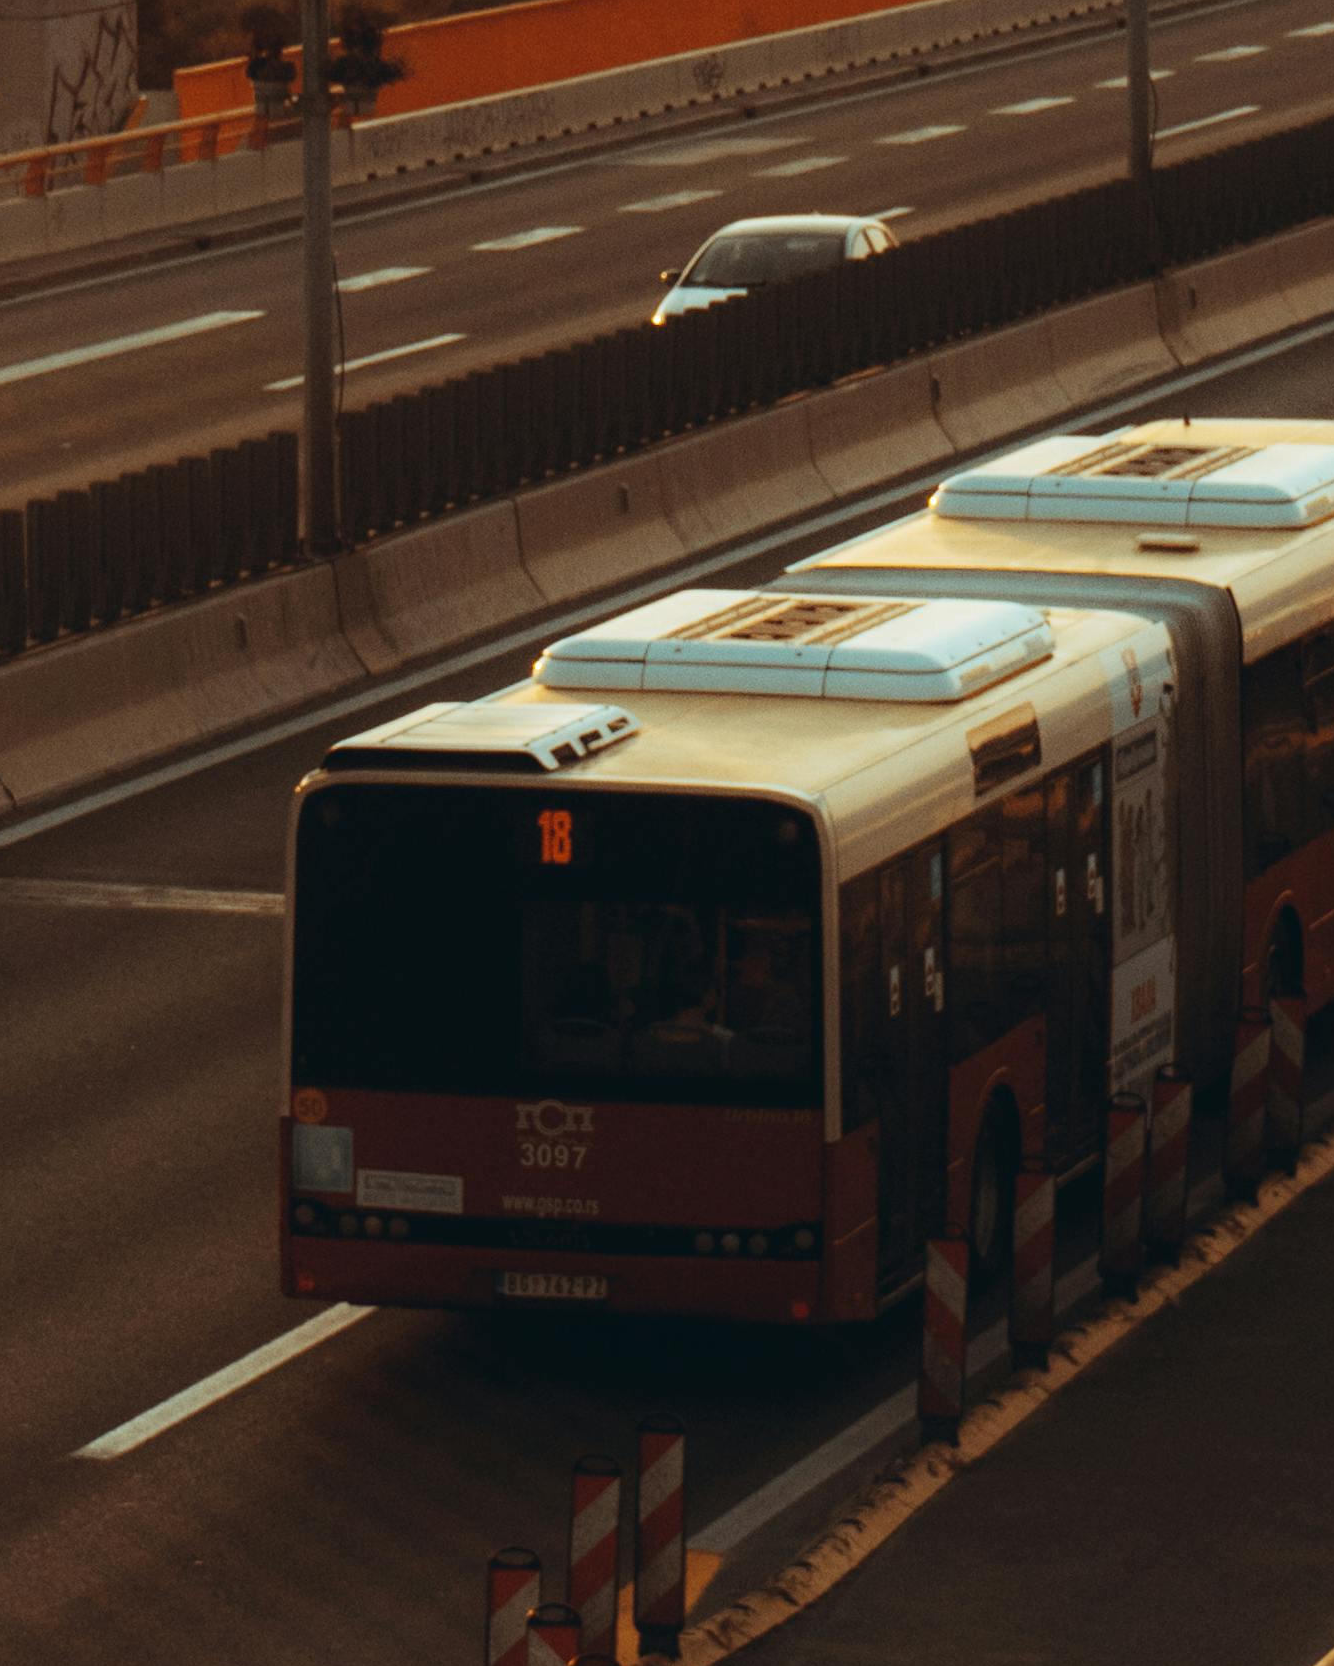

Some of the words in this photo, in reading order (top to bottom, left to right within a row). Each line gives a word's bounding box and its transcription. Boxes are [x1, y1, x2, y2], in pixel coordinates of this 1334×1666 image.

[539, 810, 572, 863] 18
[520, 1143, 587, 1170] 3097
[501, 1195, 600, 1218] www.gsp.co.rs
